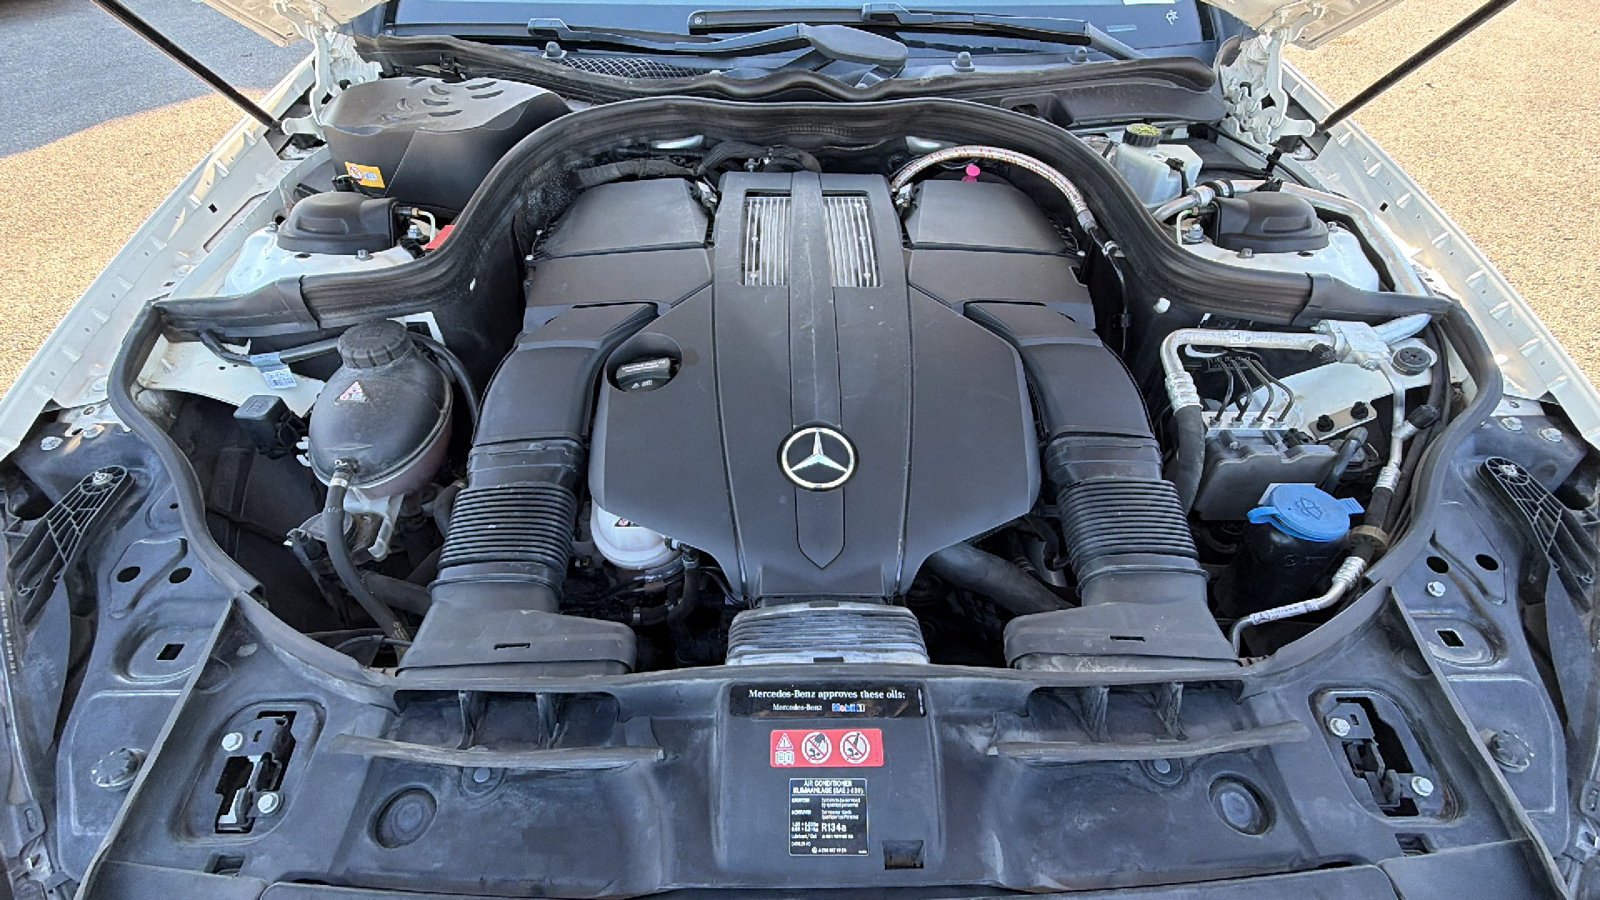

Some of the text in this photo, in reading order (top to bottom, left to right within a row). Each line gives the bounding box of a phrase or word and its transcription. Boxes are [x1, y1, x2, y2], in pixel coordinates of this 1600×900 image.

[748, 689, 906, 700] Mercedes-Benz approves these oils:
[772, 703, 823, 711] Mercedes-Benz
[821, 822, 847, 832] R134a
